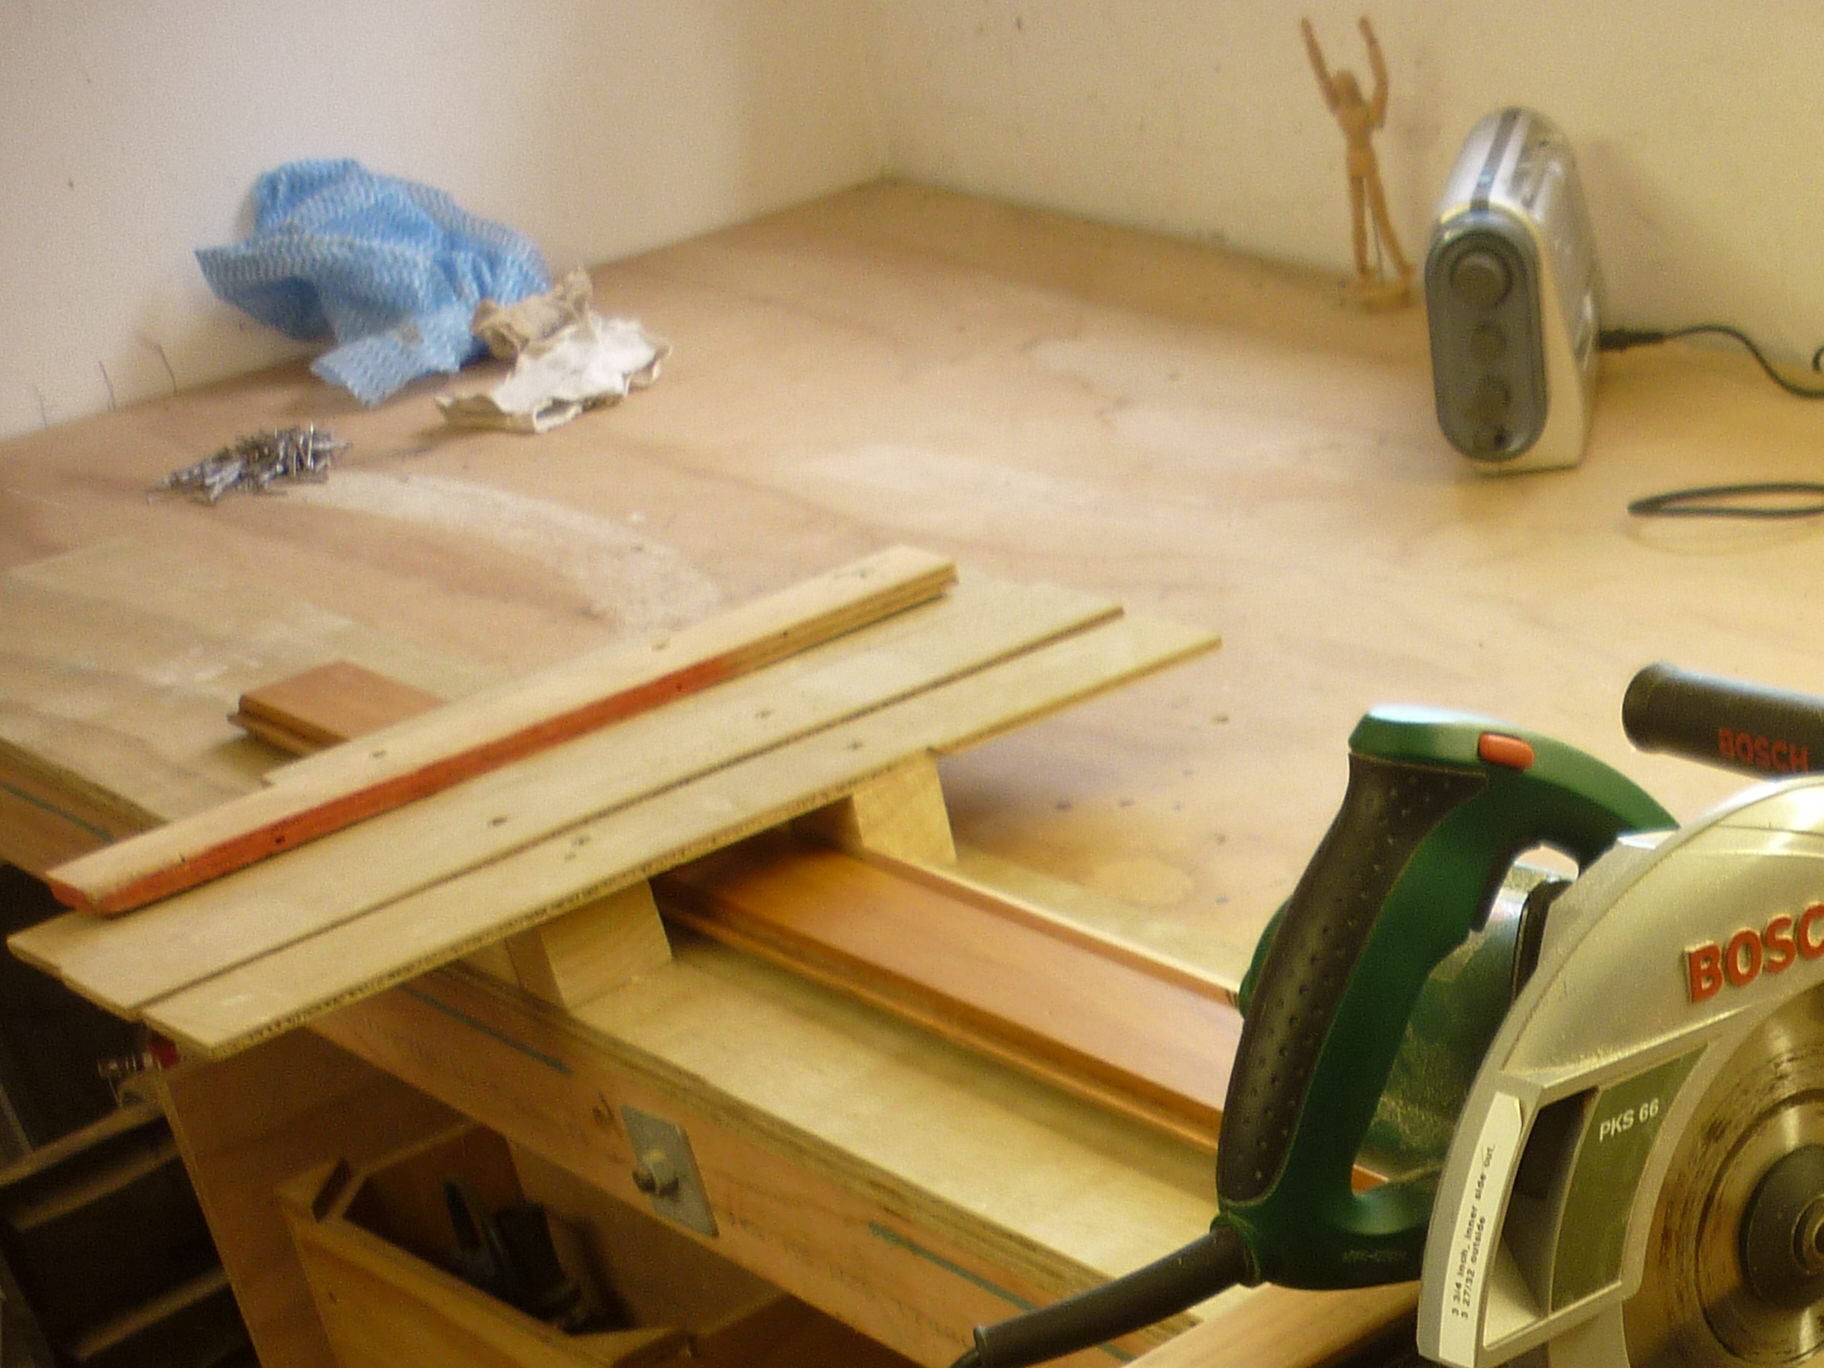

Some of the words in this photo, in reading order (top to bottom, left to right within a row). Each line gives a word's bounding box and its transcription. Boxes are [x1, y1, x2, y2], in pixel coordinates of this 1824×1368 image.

[1718, 728, 1810, 774] BOSCH
[1599, 1109, 1634, 1143] PKS
[1639, 1098, 1659, 1123] 66
[1464, 1205, 1478, 1240] inner
[1475, 1174, 1487, 1201] side
[1470, 1216, 1487, 1264] outside
